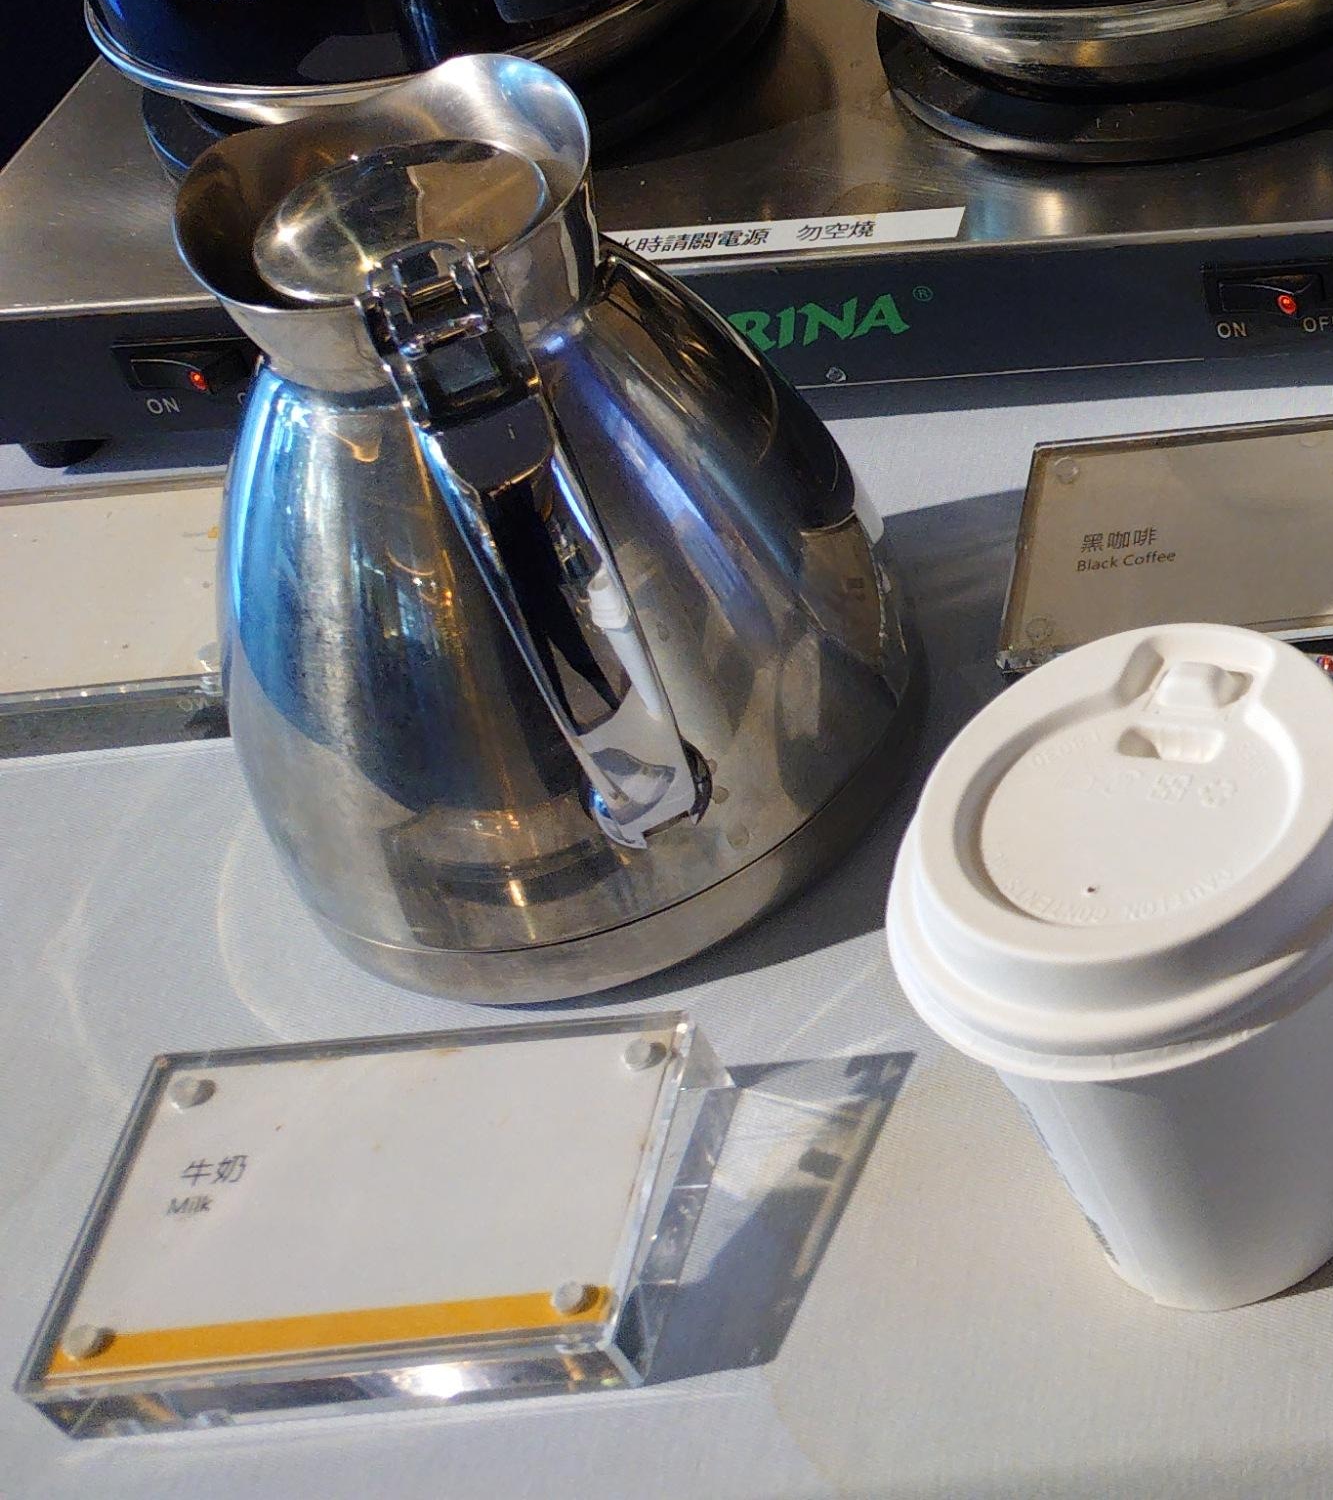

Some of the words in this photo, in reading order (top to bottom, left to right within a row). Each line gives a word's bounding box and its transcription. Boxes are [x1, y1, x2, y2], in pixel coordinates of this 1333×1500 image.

[796, 220, 878, 243] 勿空燒
[1217, 322, 1247, 339] ON
[147, 398, 180, 414] ON
[1080, 527, 1157, 553] 黑咖啡
[1077, 556, 1119, 572] Black
[1123, 550, 1176, 566] Coffee
[180, 1155, 249, 1188] 牛奶
[166, 1195, 214, 1215] Milk
